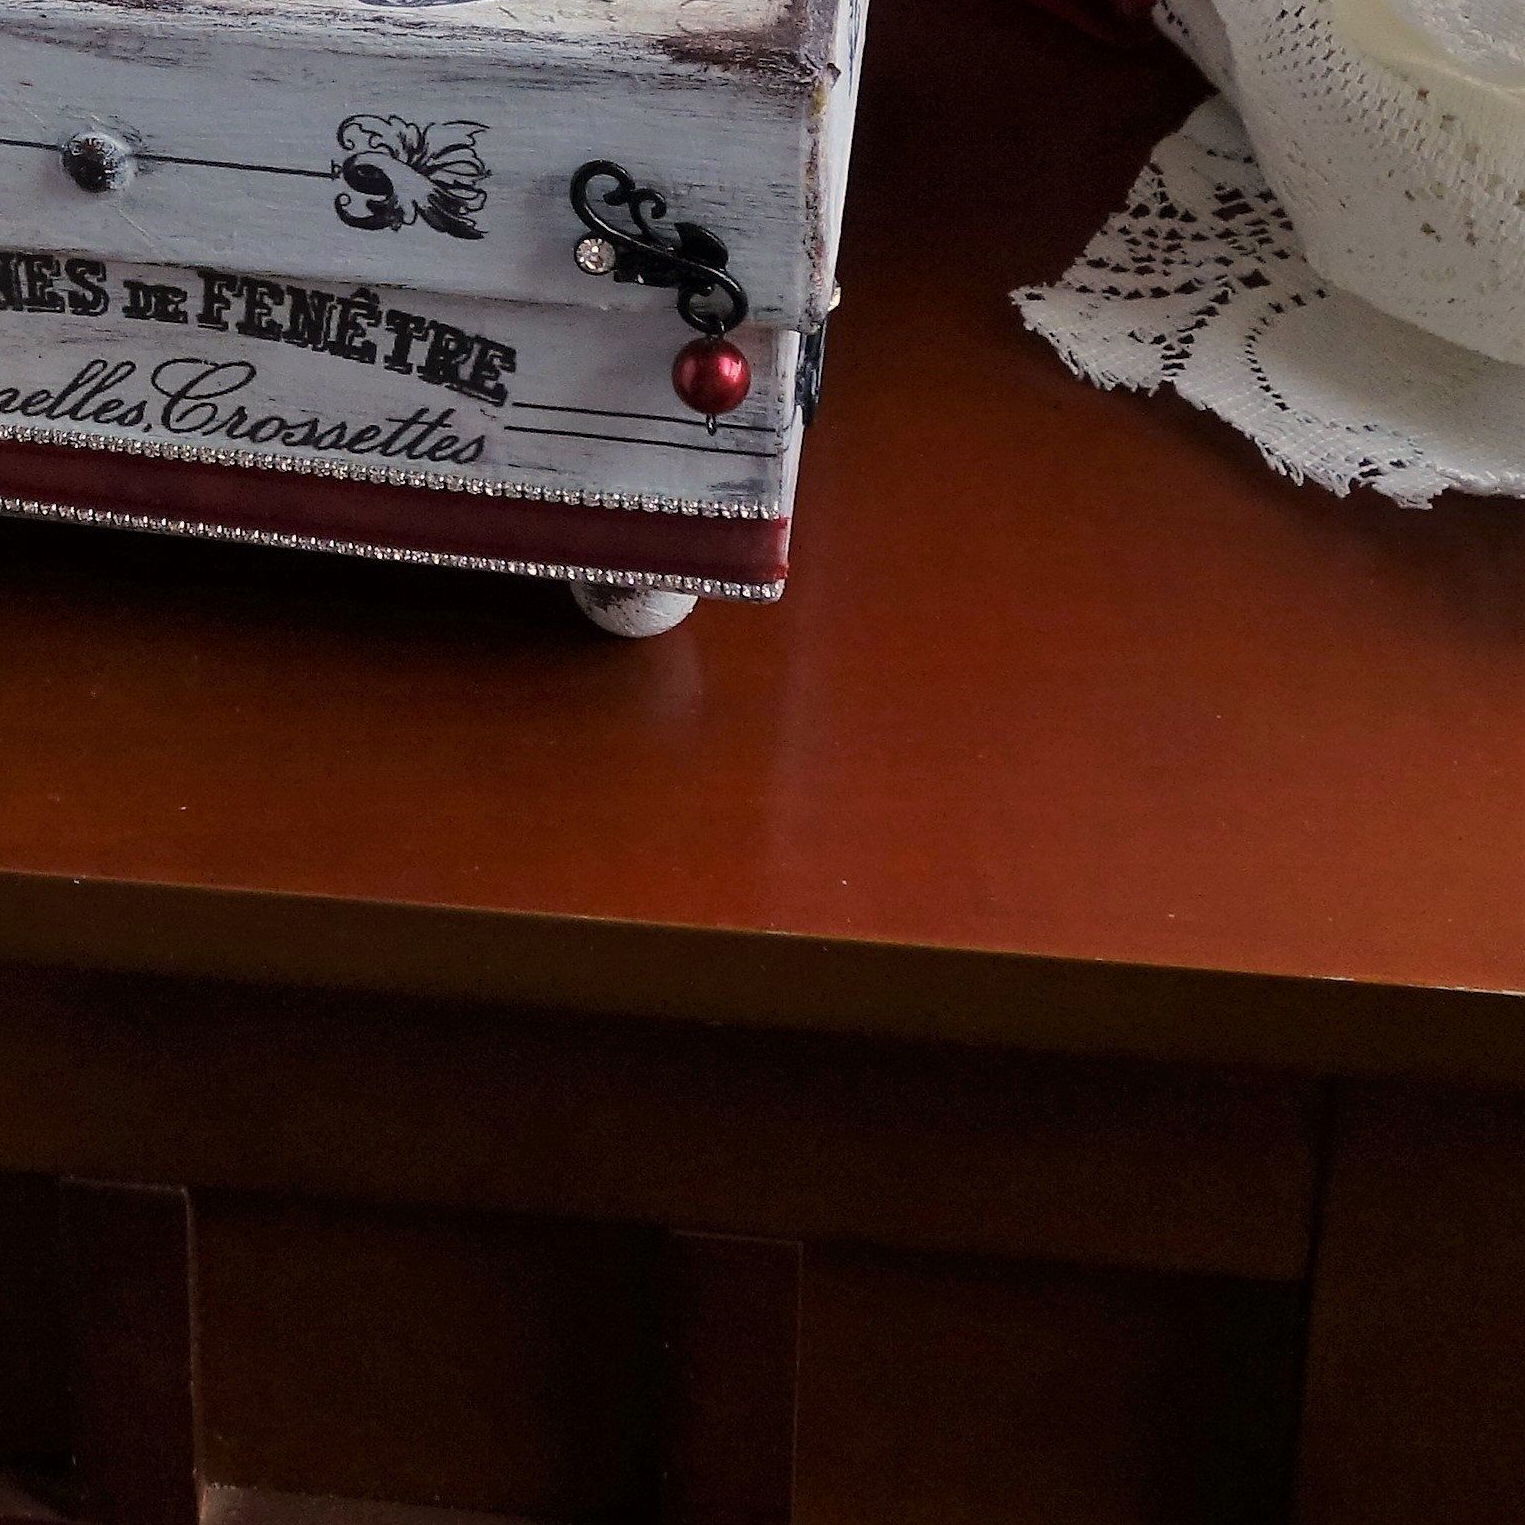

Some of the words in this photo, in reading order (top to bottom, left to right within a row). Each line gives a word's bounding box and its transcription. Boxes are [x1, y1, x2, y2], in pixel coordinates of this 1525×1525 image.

[122, 280, 189, 324] DE
[196, 270, 517, 407] FENÊTRE
[151, 357, 486, 463] Crossettes
